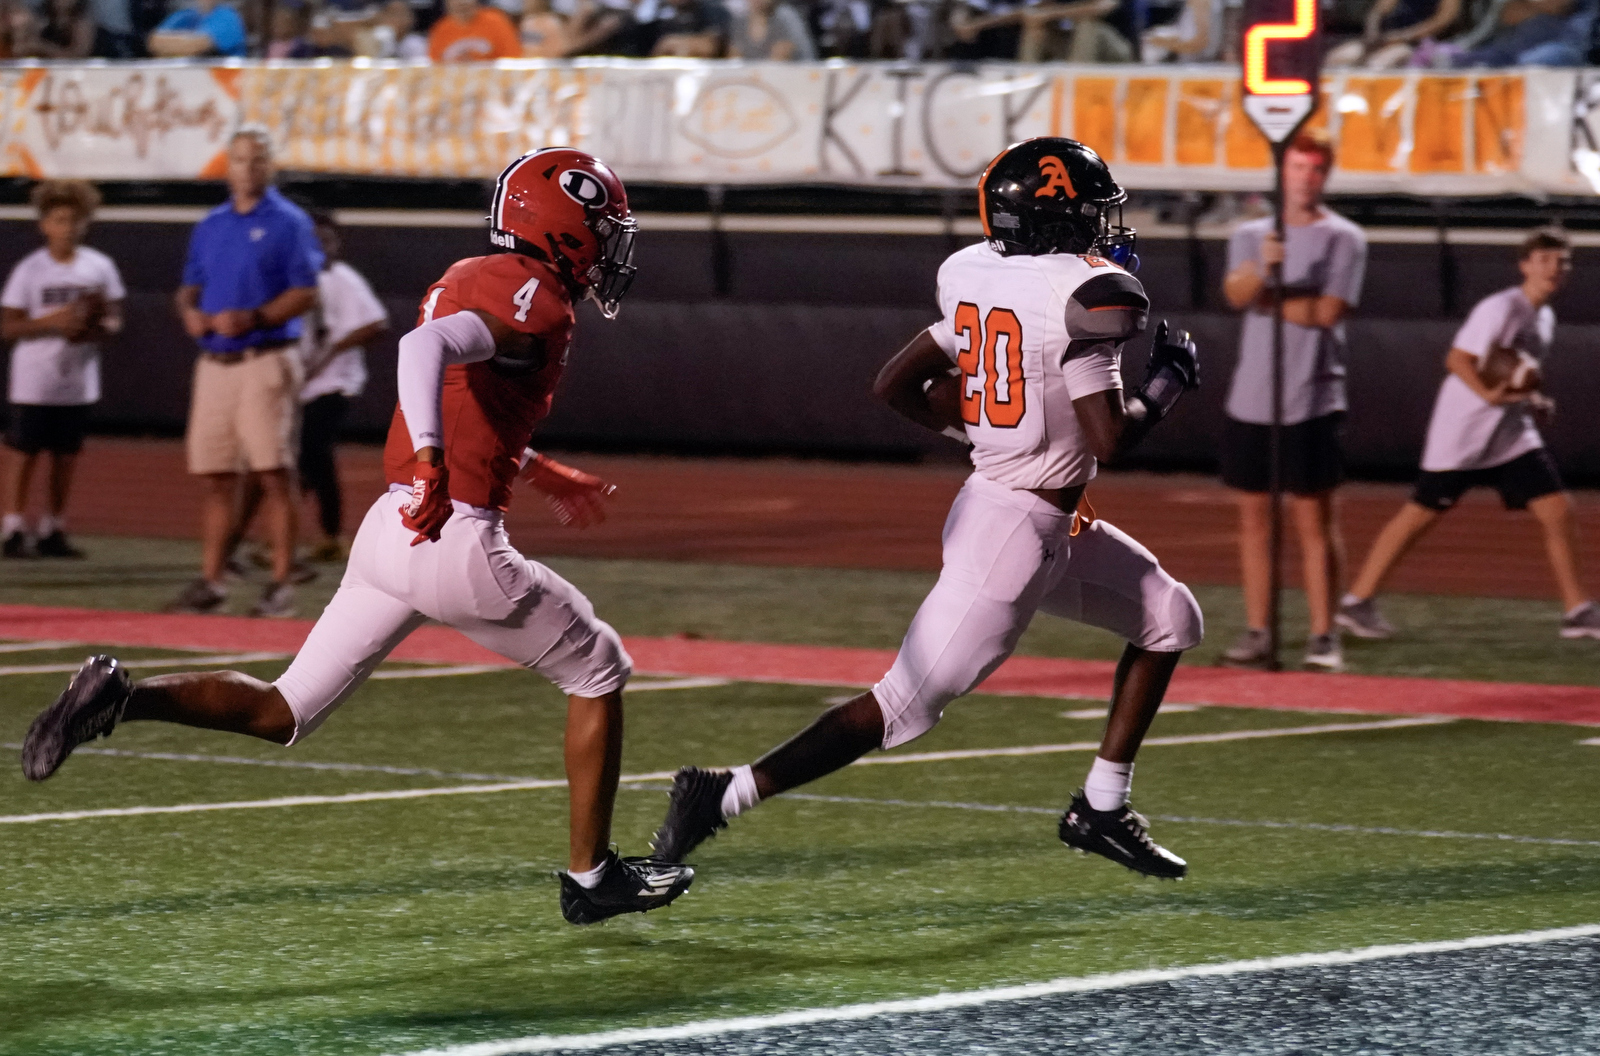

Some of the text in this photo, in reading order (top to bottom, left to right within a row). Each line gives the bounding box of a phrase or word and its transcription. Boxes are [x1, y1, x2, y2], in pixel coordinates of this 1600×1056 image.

[818, 68, 1050, 179] KICK
[563, 171, 607, 207] D
[1034, 155, 1078, 199] A
[512, 277, 541, 323] 4
[954, 301, 1026, 429] 20
